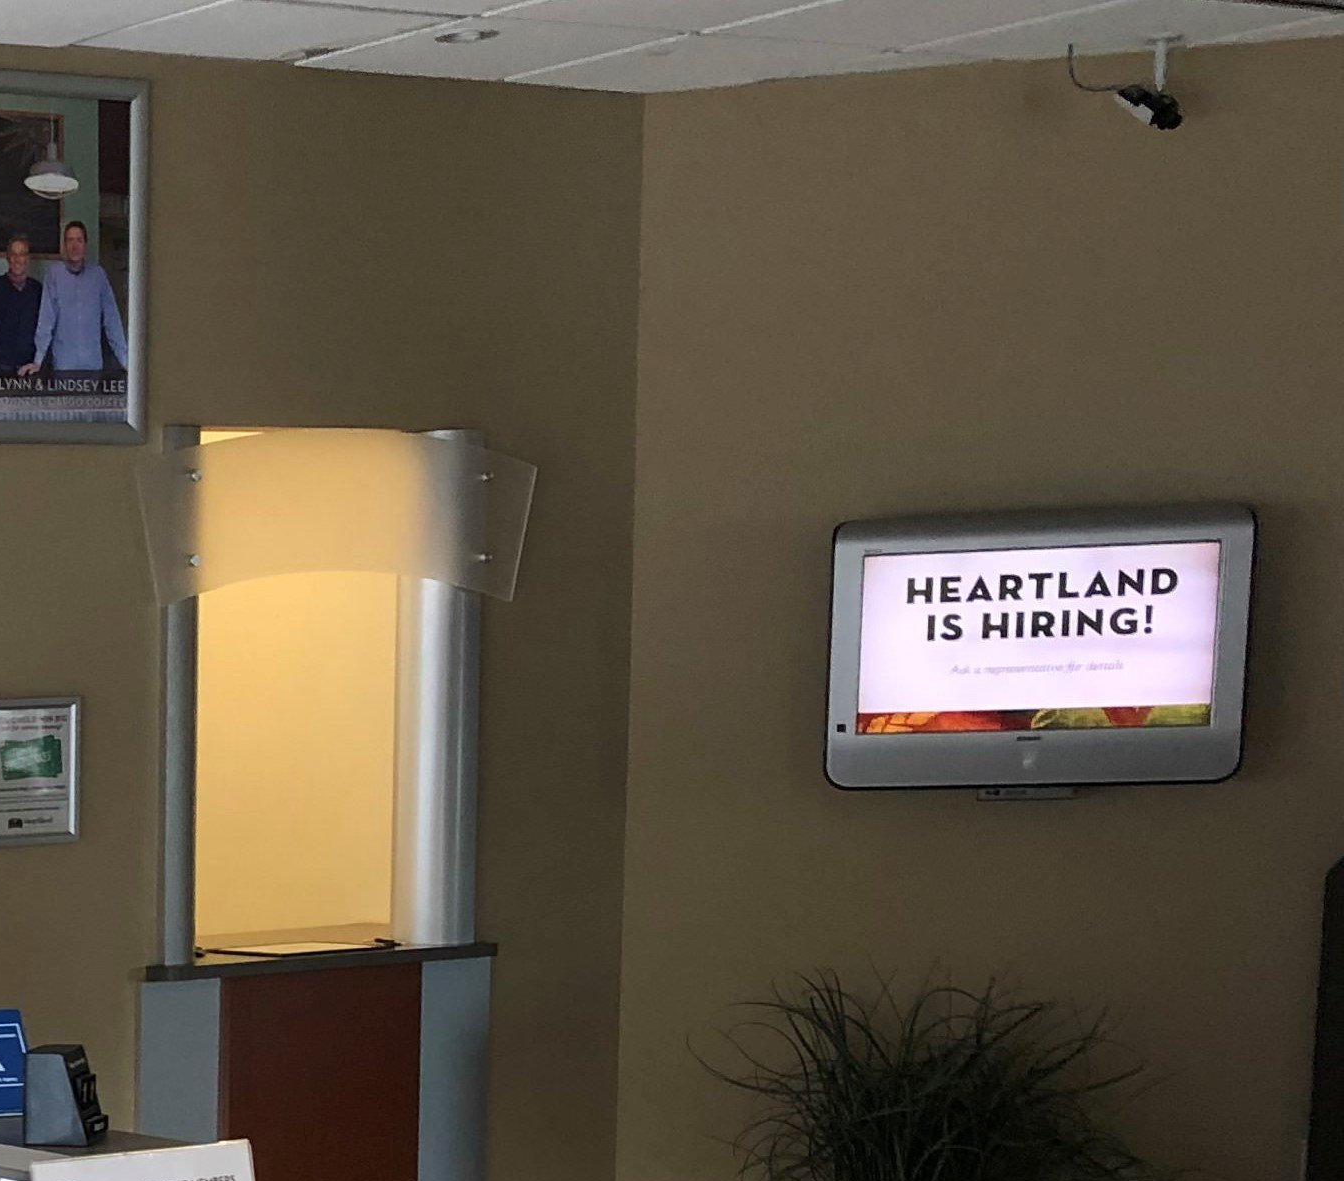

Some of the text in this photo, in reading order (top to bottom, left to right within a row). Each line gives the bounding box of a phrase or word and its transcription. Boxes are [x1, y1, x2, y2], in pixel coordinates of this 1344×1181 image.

[35, 378, 44, 391] &
[47, 379, 99, 392] LINDSEY
[102, 380, 126, 393] LEE
[906, 567, 1179, 604] HEARTLAND
[926, 605, 1154, 641] IS HIRING!
